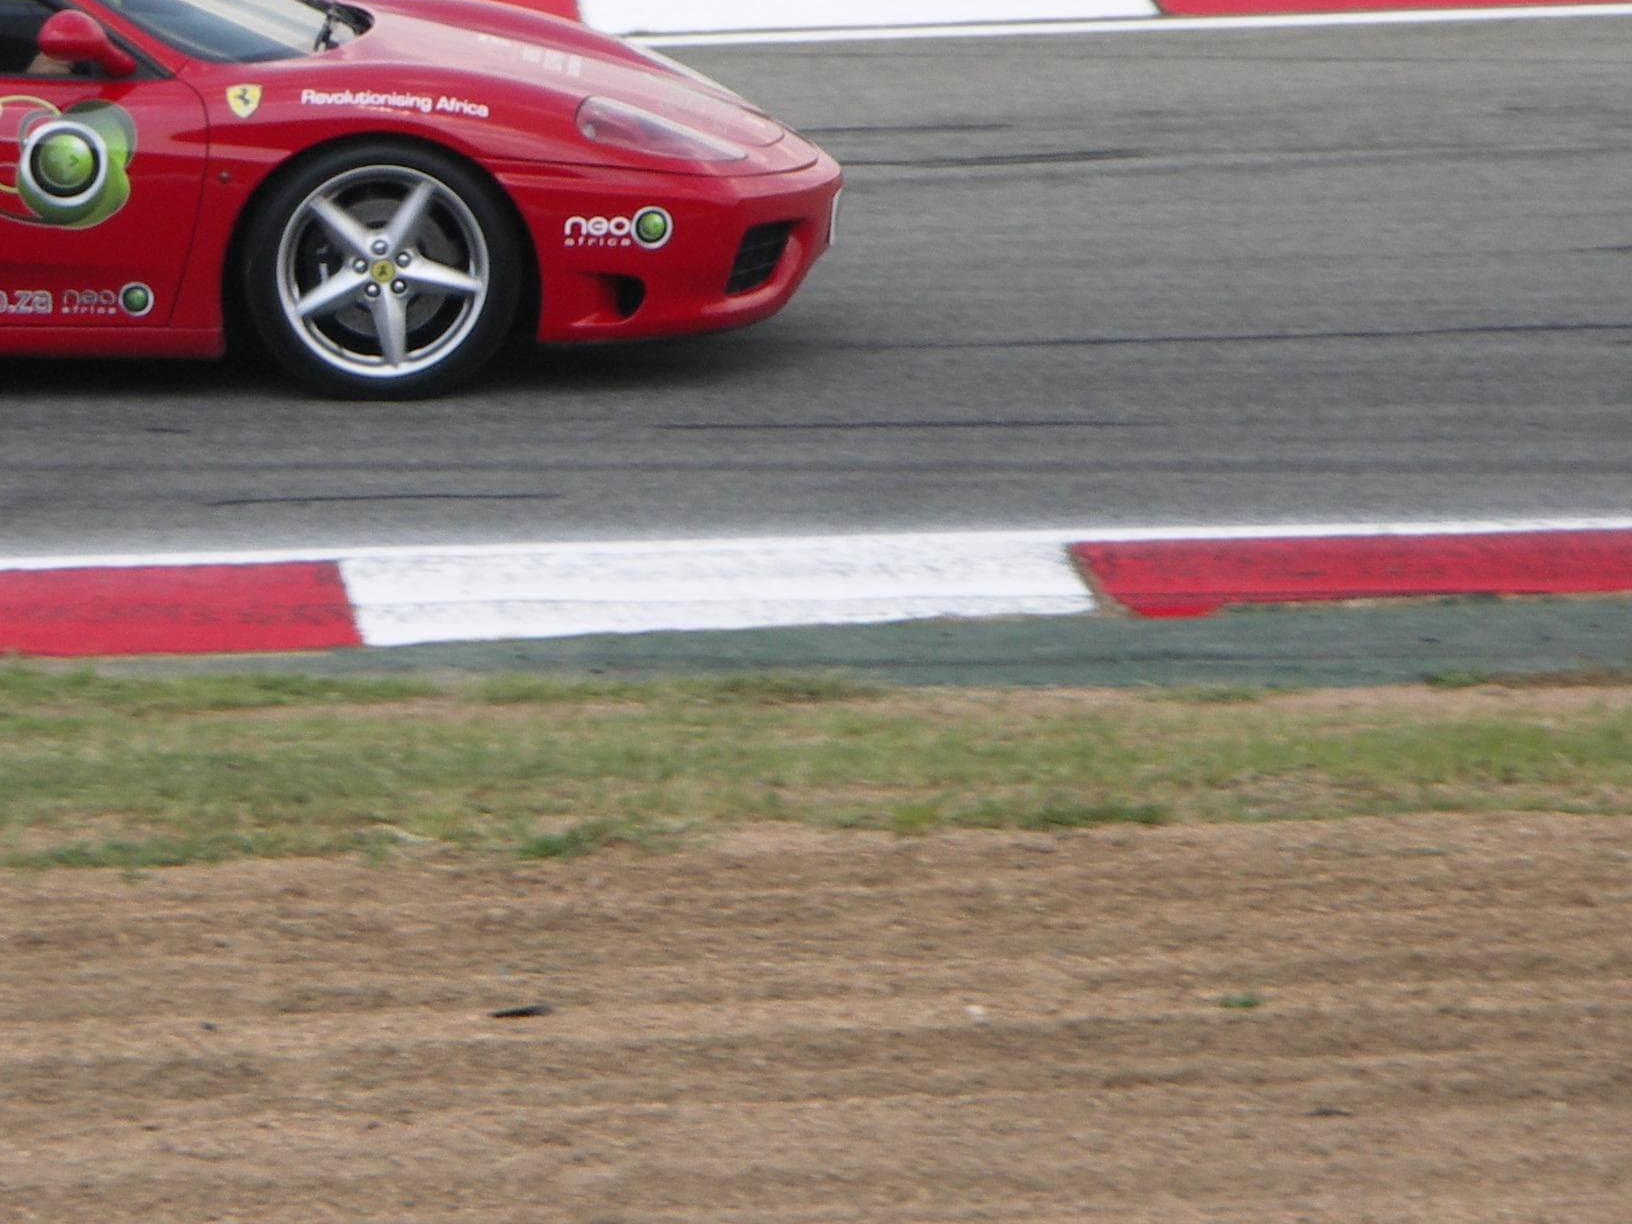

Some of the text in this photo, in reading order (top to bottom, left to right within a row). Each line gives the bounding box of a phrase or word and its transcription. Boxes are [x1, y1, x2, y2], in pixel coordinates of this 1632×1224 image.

[301, 89, 489, 118] Revolutionising Africa
[564, 216, 631, 236] neo
